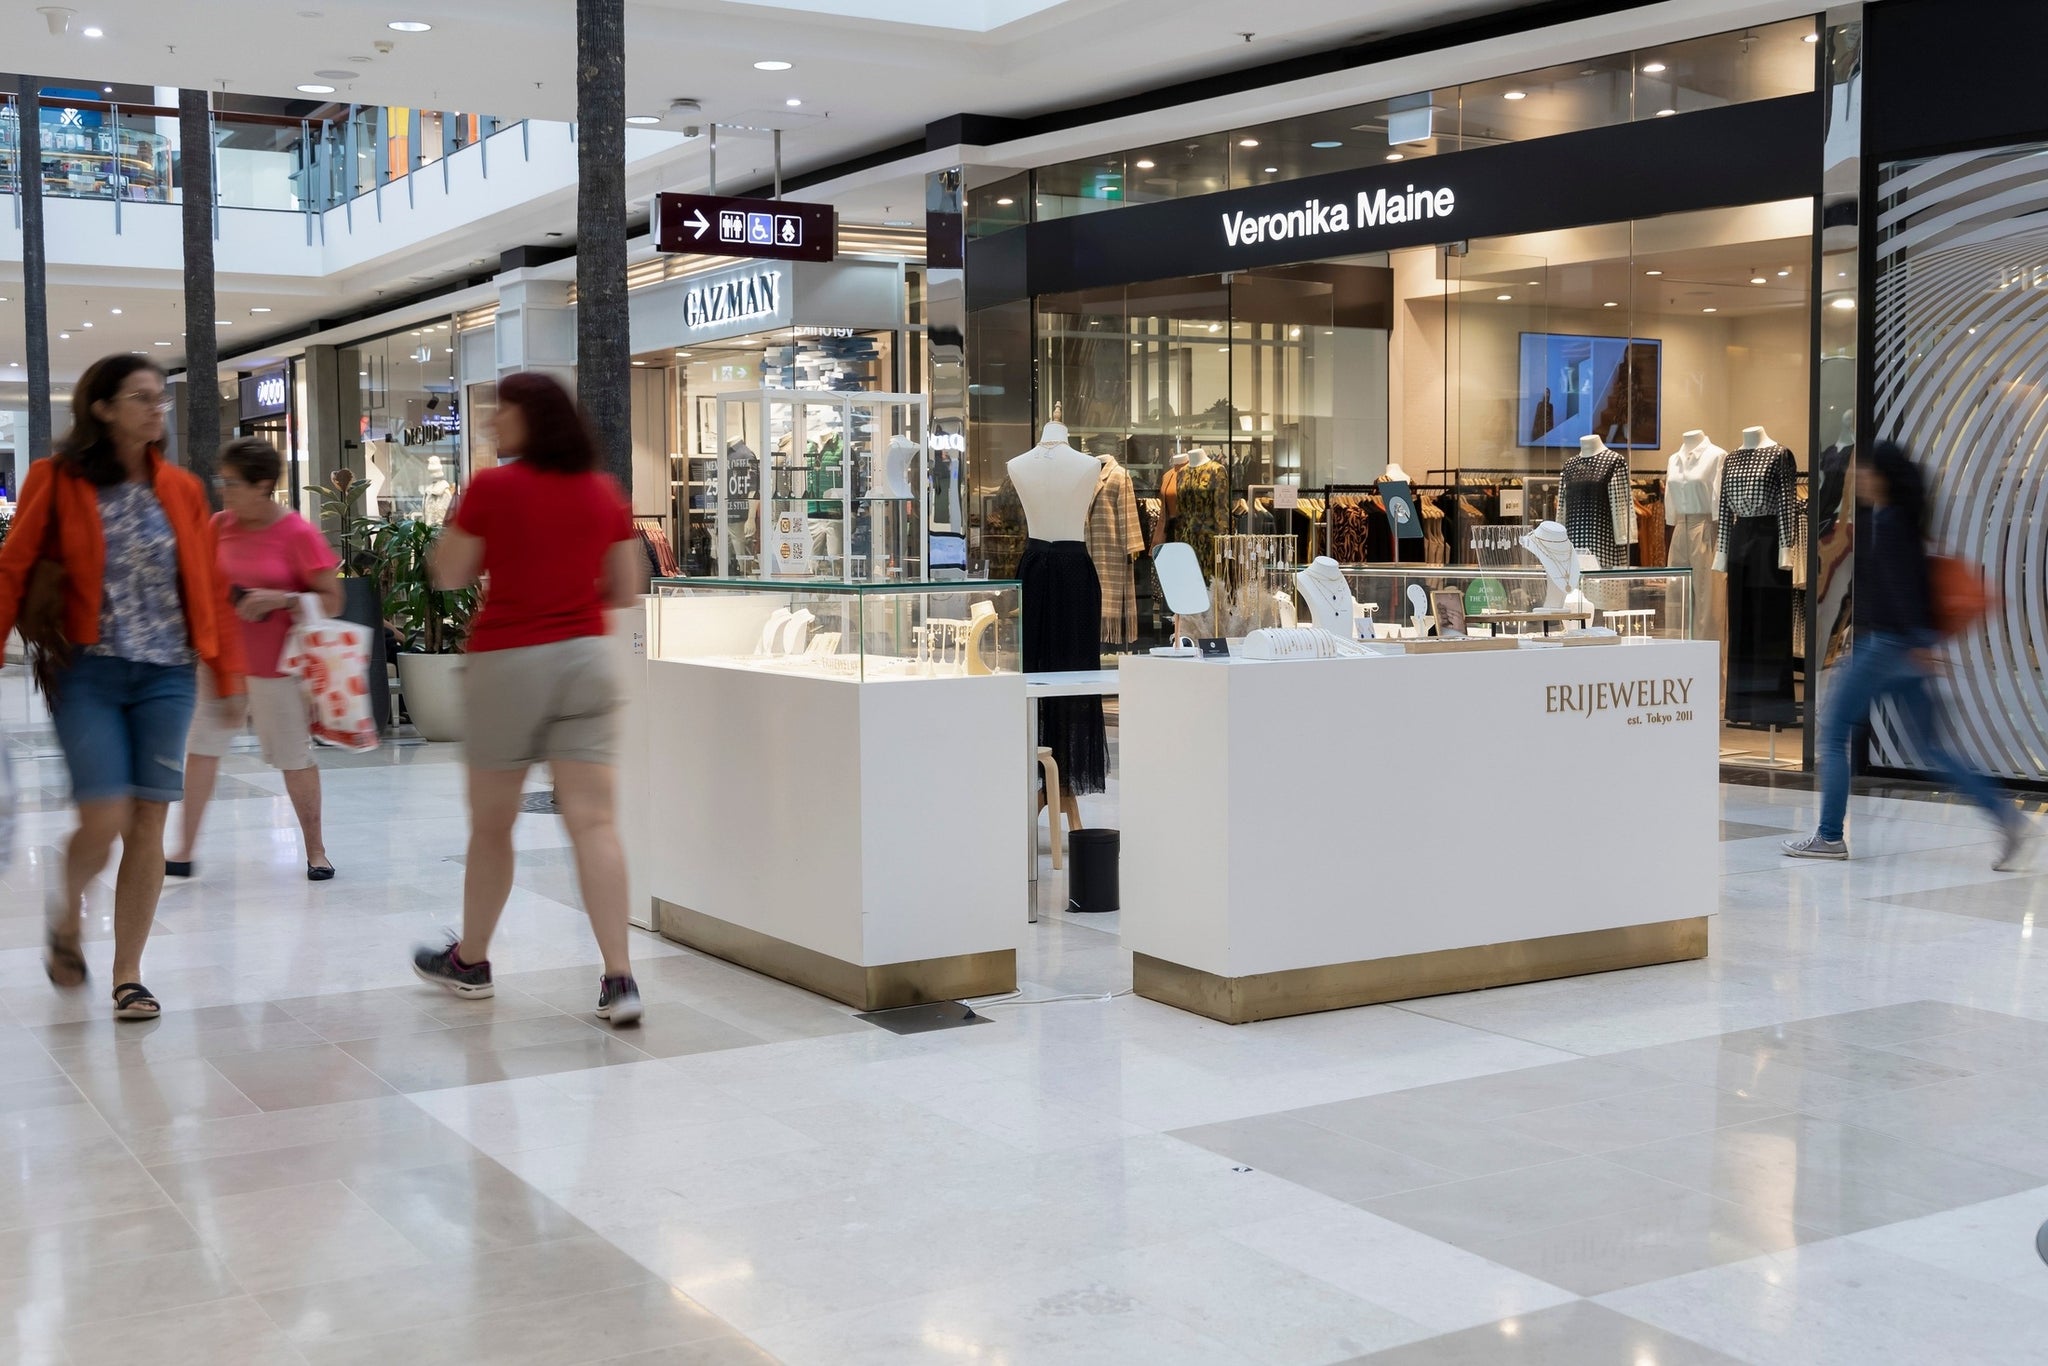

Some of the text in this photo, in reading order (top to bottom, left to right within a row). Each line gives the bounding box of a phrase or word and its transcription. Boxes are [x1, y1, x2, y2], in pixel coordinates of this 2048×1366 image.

[1221, 183, 1455, 247] Veronika Maine
[683, 273, 775, 327] GAZMAN
[706, 476, 751, 496] 25 OFF
[1469, 595, 1481, 603] THE
[1545, 677, 1694, 719] ERIJEWELRY
[1627, 710, 1693, 726] est. Tokyo 2011
